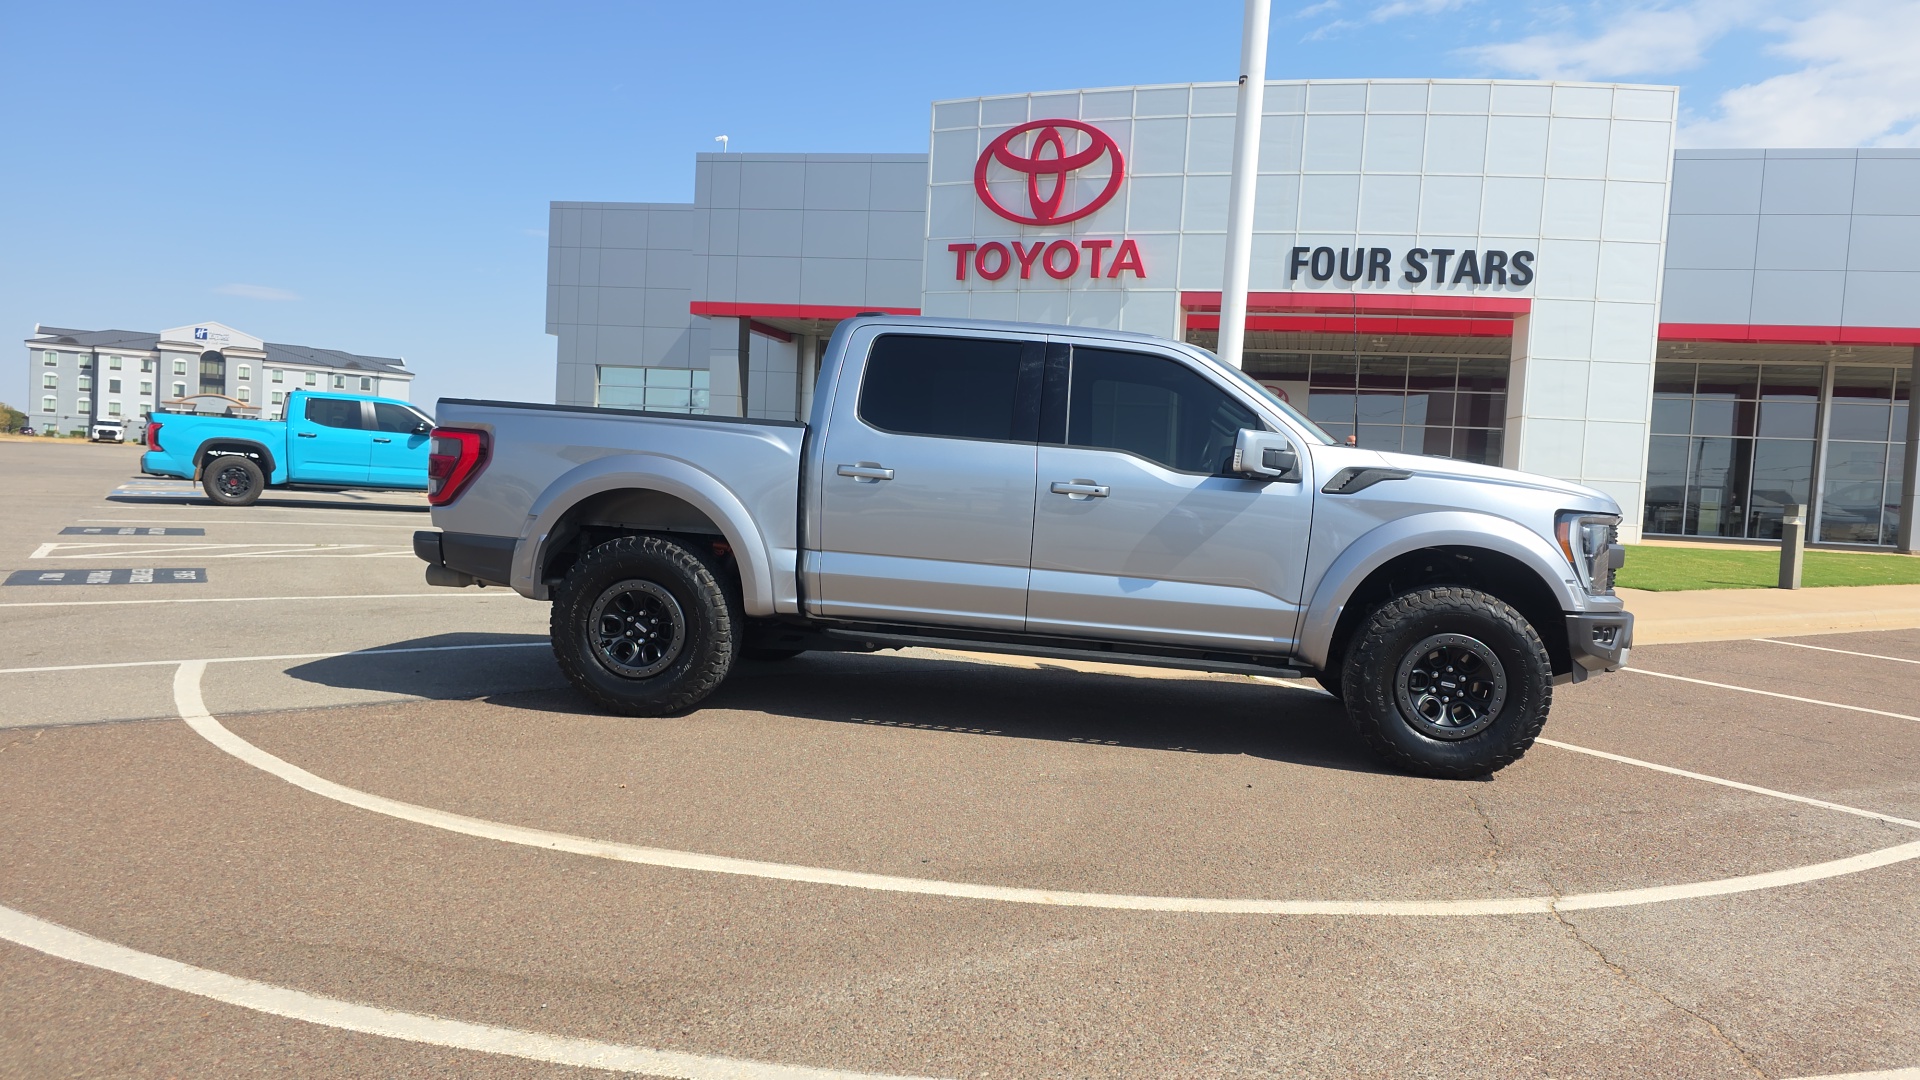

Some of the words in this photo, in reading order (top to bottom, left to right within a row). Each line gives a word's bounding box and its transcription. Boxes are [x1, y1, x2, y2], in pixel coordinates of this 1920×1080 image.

[948, 239, 1147, 280] TOYOTA
[1290, 246, 1392, 281] FOUR
[1404, 247, 1535, 285] STARS
